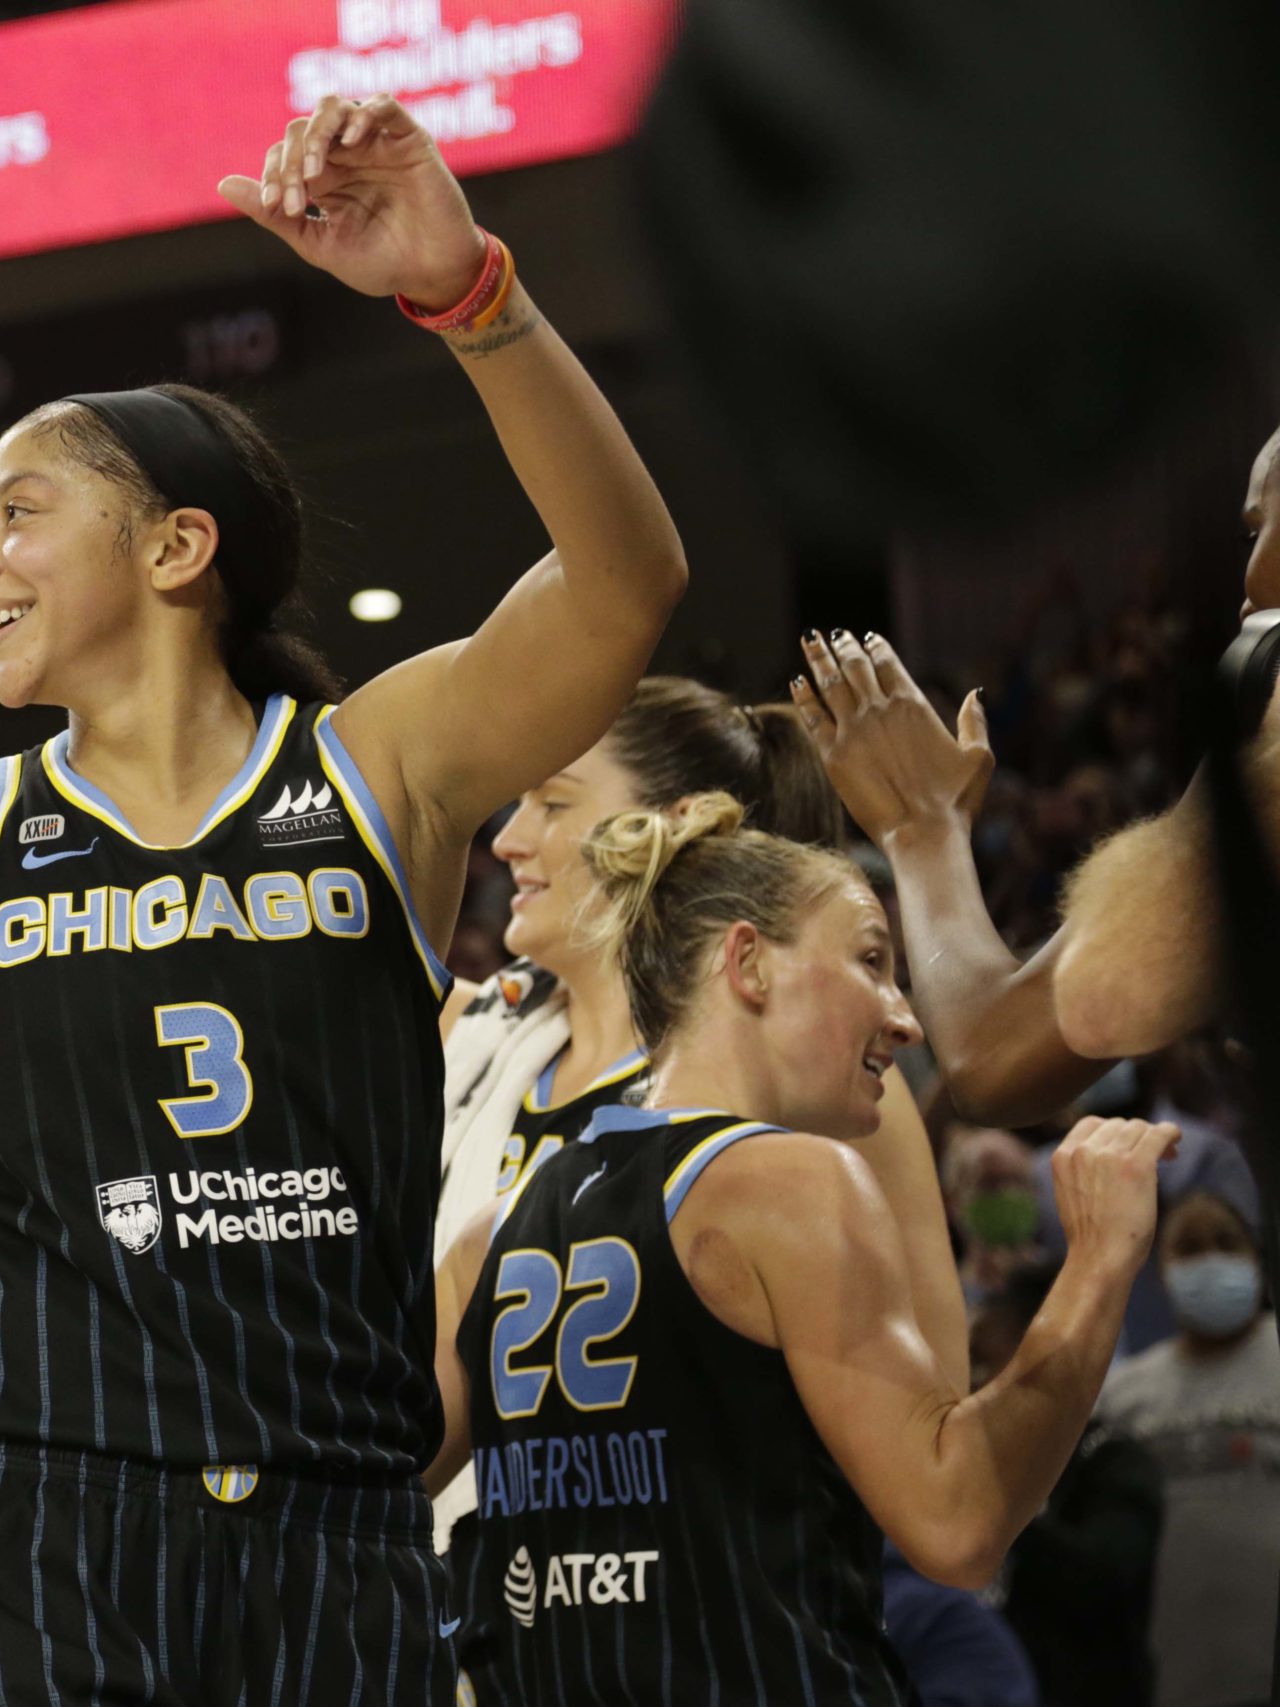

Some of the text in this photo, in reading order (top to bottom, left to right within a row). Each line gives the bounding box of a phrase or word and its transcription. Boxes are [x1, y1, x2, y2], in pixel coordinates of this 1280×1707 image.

[288, 12, 583, 112] Shoulders
[259, 813, 341, 834] MAGELLAN
[154, 1001, 253, 1138] 3
[169, 1166, 347, 1205] UChicago
[176, 1203, 358, 1248] Medicine
[491, 1236, 641, 1420] 22
[544, 1551, 659, 1608] AT&T
